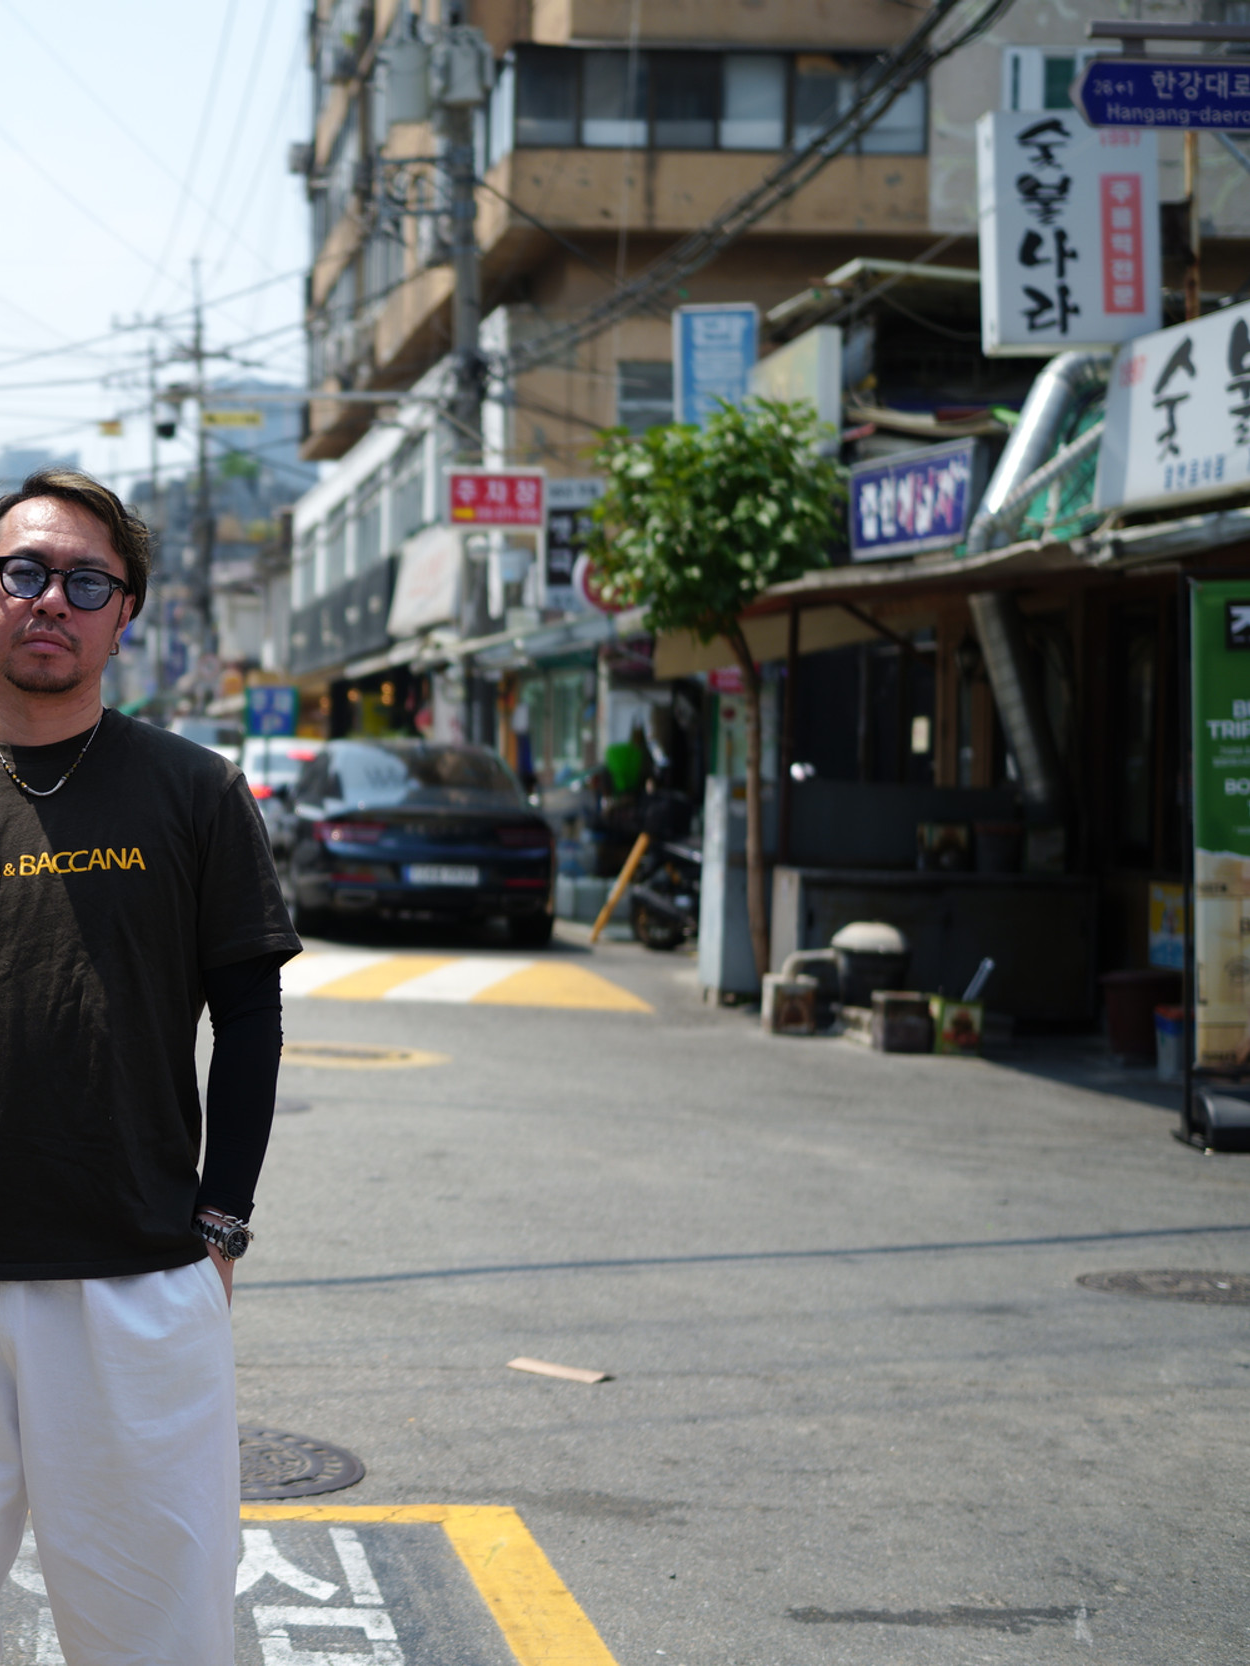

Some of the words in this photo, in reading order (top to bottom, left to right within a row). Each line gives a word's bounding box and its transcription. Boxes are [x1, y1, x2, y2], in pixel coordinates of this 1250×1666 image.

[1151, 69, 1250, 101] 한강대로
[1015, 117, 1080, 336] 숯불나라
[2, 862, 15, 877] &
[19, 848, 146, 876] BACCANA
